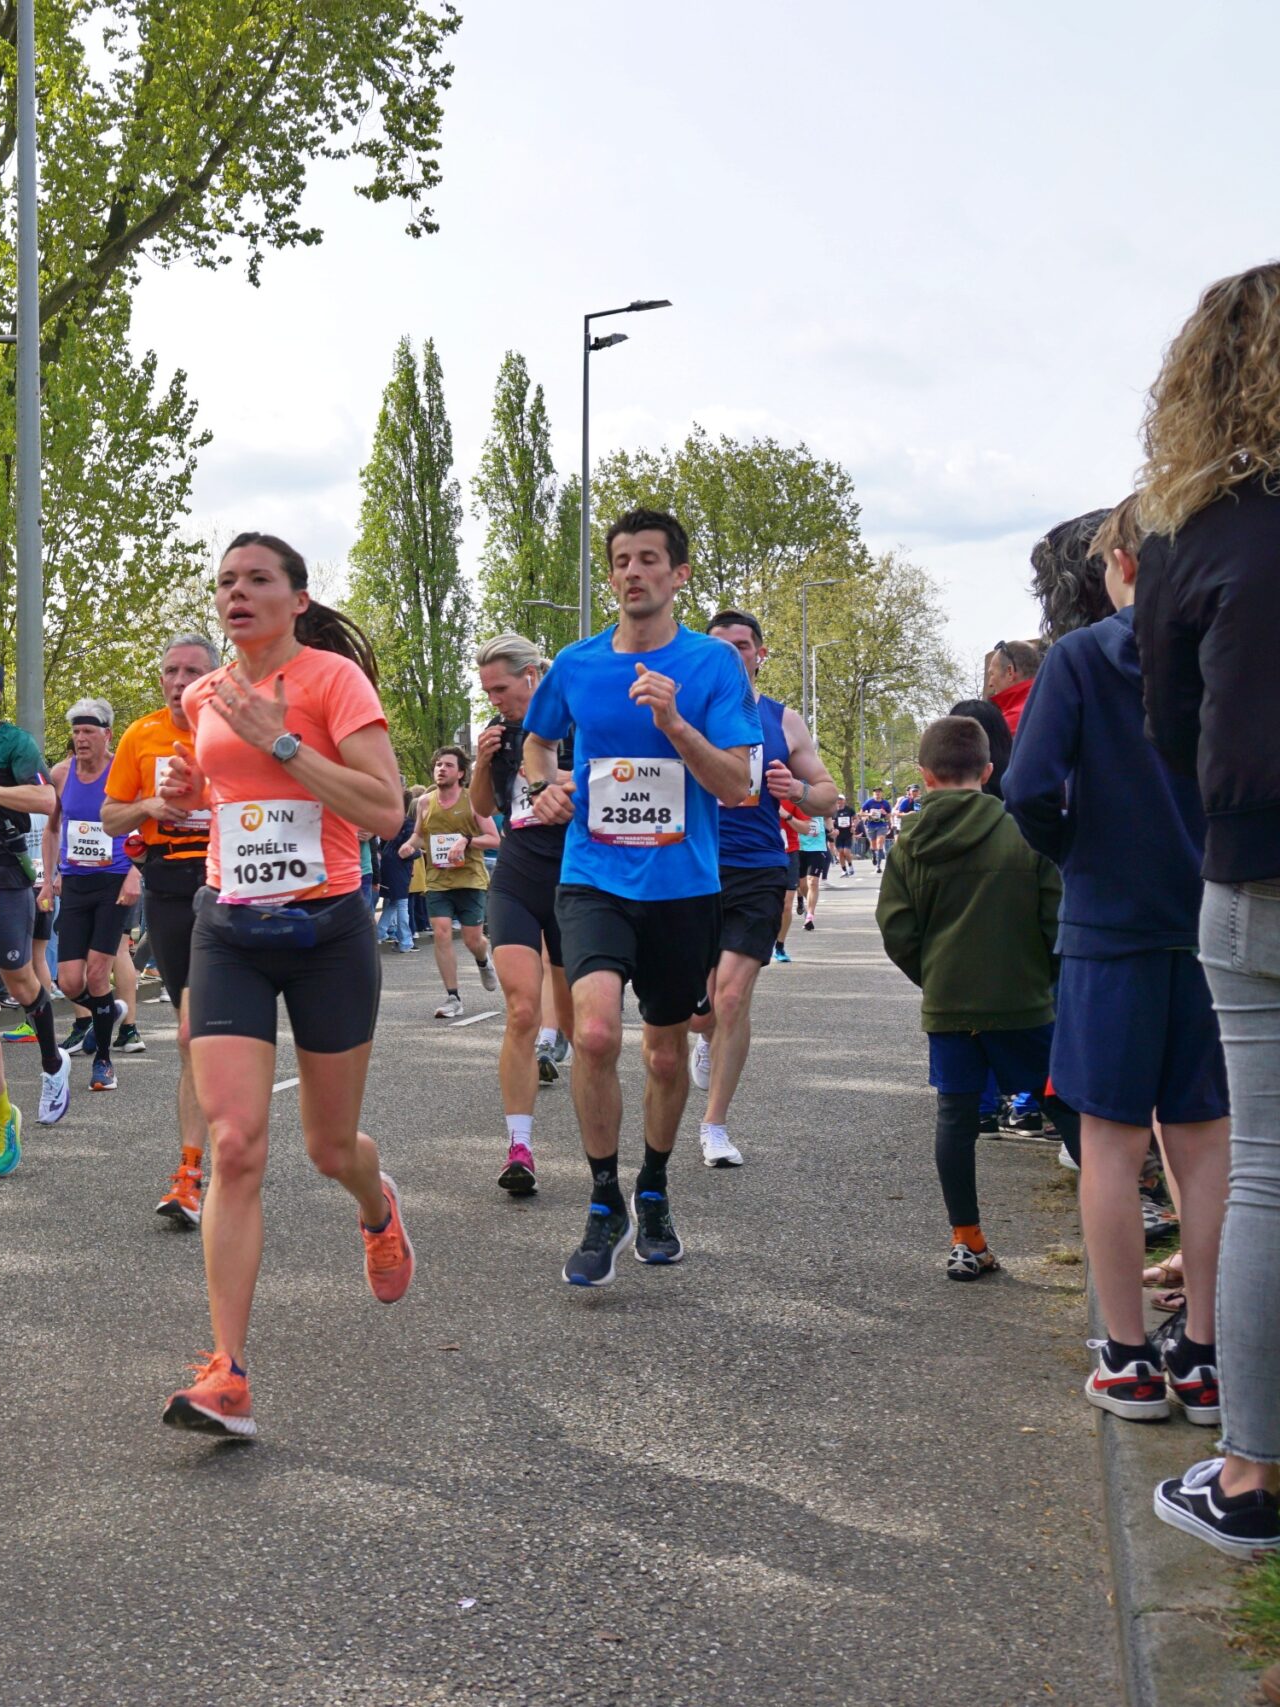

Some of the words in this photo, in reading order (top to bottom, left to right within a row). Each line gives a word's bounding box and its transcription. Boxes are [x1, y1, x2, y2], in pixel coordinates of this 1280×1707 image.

[637, 767, 660, 777] NN
[621, 792, 651, 802] JAN
[266, 810, 294, 823] NN
[601, 807, 672, 824] 23848
[72, 846, 106, 857] 22092
[237, 838, 298, 857] OPHÉLIE
[234, 859, 307, 885] 10370
